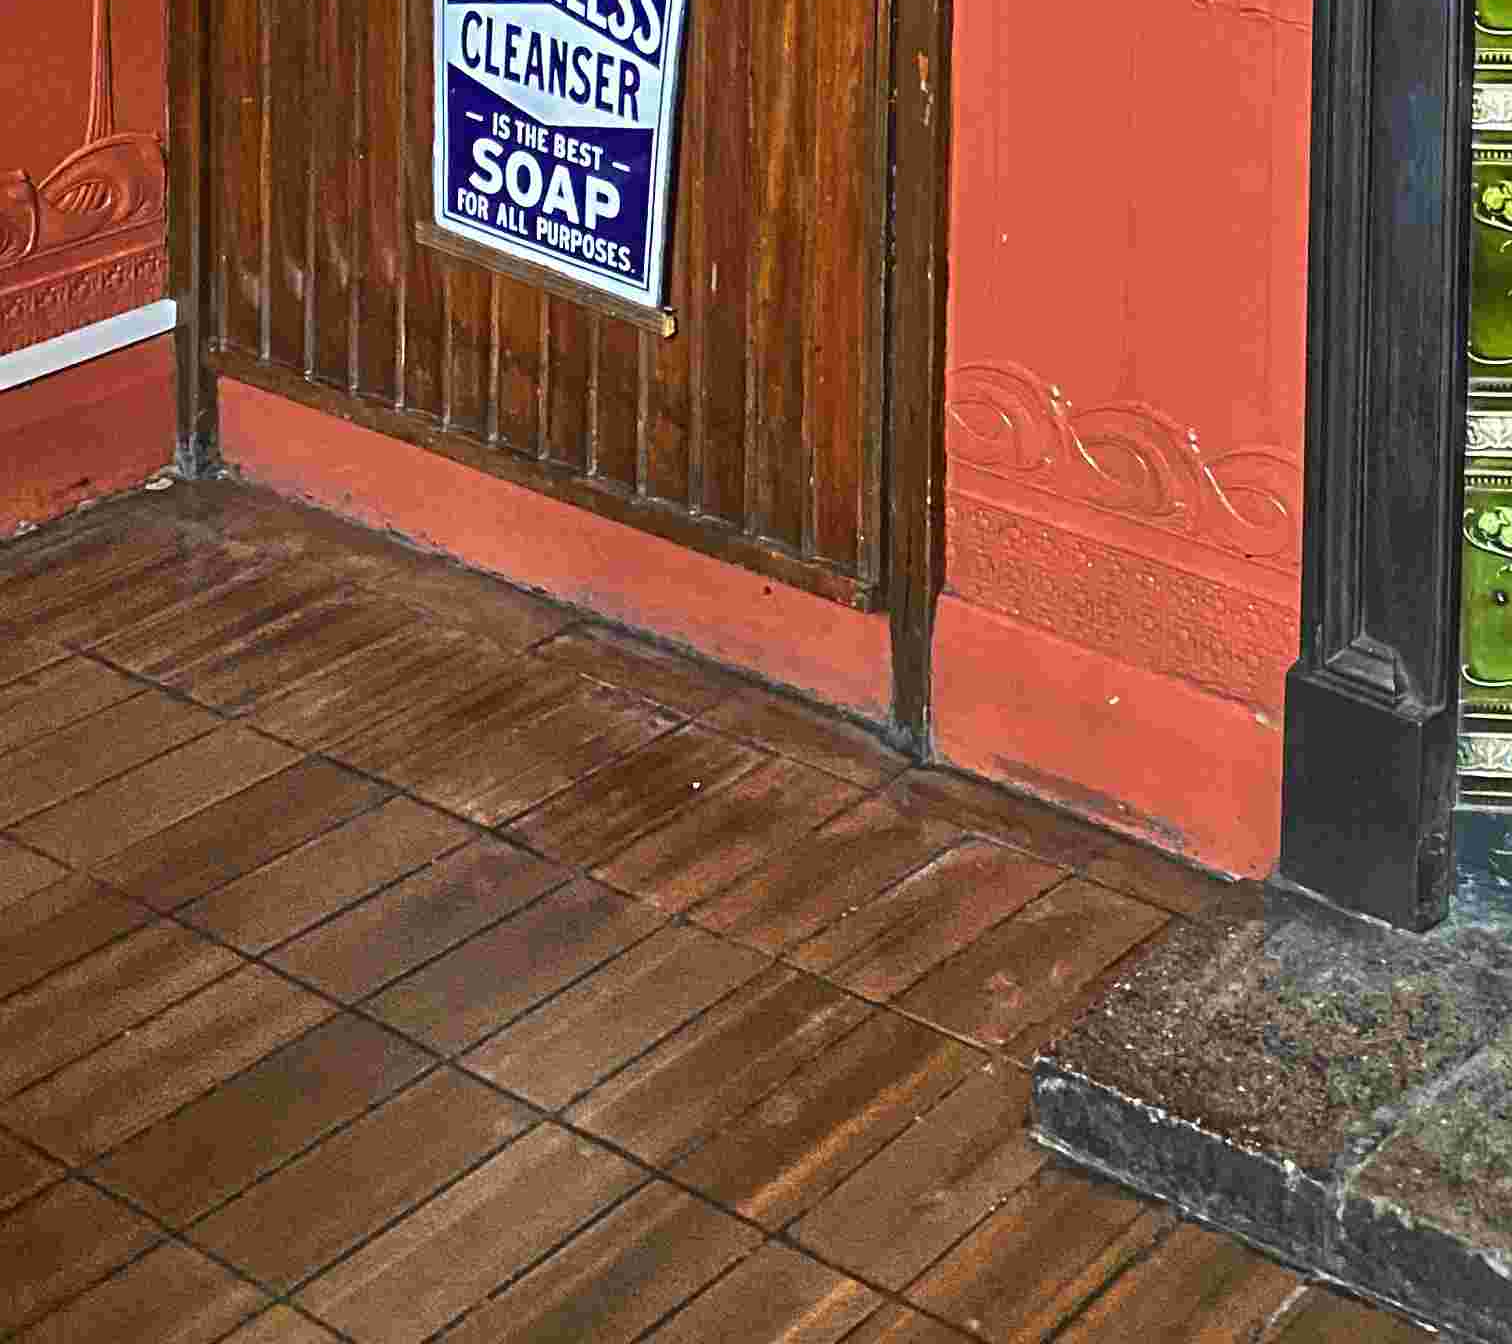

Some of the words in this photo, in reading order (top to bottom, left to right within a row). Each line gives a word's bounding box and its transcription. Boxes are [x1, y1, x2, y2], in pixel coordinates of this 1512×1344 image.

[460, 10, 641, 122] CLEANSER
[468, 137, 621, 230] SOAP
[492, 112, 510, 140] IS
[516, 120, 549, 153] THE
[553, 134, 604, 172] BEST
[457, 187, 489, 223] FOR
[496, 203, 528, 235] ALL
[536, 216, 637, 274] PURPOSES.
